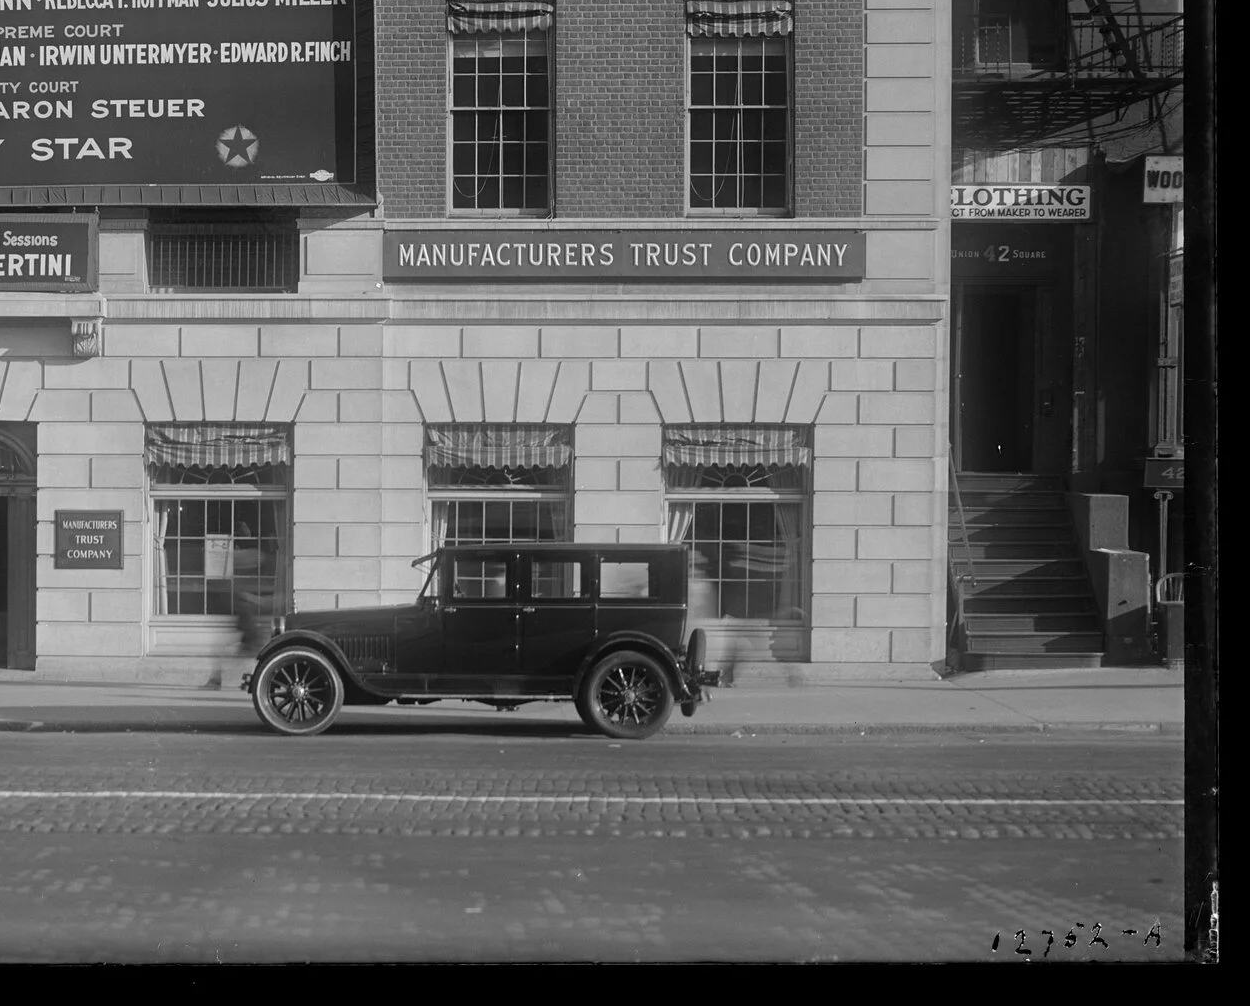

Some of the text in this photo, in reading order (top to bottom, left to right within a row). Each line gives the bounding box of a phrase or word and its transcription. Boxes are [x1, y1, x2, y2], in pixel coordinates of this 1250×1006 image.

[64, 24, 124, 38] COURT
[39, 44, 96, 66] IRWIN
[100, 42, 212, 65] UNTERMYER
[220, 41, 289, 63] EDWARD
[29, 80, 79, 94] COURT
[91, 98, 205, 119] STEUER
[31, 137, 133, 162] STAR
[950, 188, 1087, 207] LOTHING
[968, 208, 995, 218] FROM
[997, 208, 1030, 218] MAKER
[1033, 208, 1045, 218] TO
[1048, 208, 1087, 218] WEARER
[2, 230, 58, 247] Sessions
[399, 242, 848, 267] MANUFACTURERS TRUST COMPANY
[62, 519, 118, 530] MANUFACTURERS
[75, 534, 105, 545] TRUST
[66, 549, 113, 560] COMPANY
